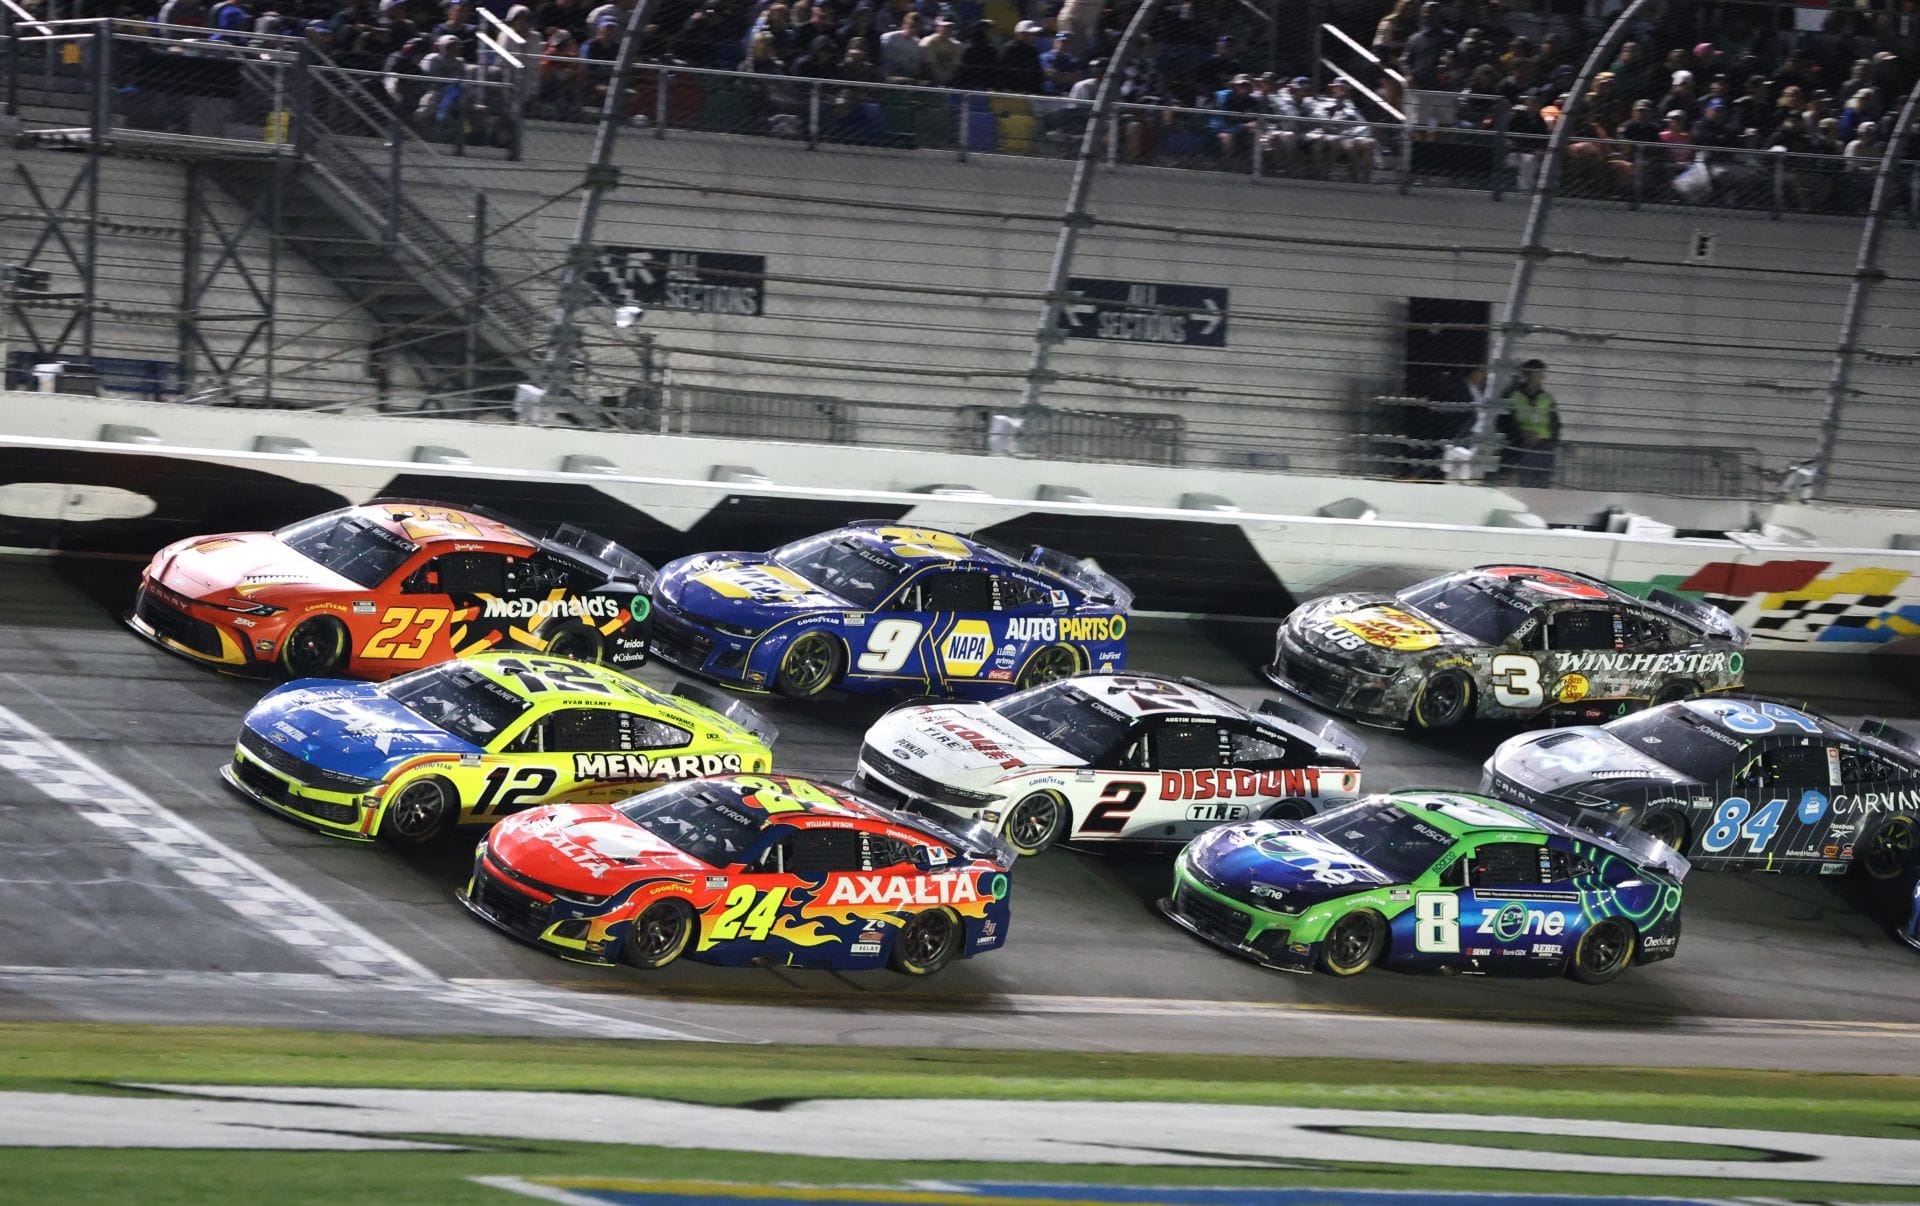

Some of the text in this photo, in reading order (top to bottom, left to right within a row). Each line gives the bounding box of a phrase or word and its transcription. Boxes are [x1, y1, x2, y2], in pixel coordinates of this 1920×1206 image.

[371, 527, 414, 552] WALLACE
[859, 550, 898, 570] ELLIOTT
[304, 602, 348, 612] GOODYEAR
[484, 595, 620, 618] McDonald's
[1494, 592, 1533, 614] DILLON
[359, 606, 451, 660] 23
[796, 616, 840, 626] GOODYEAR
[1004, 617, 1109, 642] AUTO PARTS
[623, 639, 645, 649] leidos
[857, 618, 923, 672] 9
[949, 635, 986, 661] NAPA
[1554, 652, 1726, 674] WINCHESTER
[1492, 654, 1544, 708] 3
[484, 683, 521, 704] BLANEY
[1090, 701, 1126, 722] CINDRIC
[1714, 699, 1824, 735] 84
[1695, 724, 1744, 750] JOHNSON
[573, 751, 742, 782] MENARDS
[470, 766, 558, 816] 12
[1029, 775, 1065, 787] GOODYEAR
[1159, 767, 1321, 801] DISCOUNT
[1493, 779, 1537, 805] CAMRY
[1078, 780, 1148, 834] 2
[1193, 806, 1242, 820] TIRE
[1647, 796, 1688, 808] GOODYEAR
[715, 803, 752, 826] BYRON
[805, 821, 831, 829] WILLIAM
[1701, 796, 1789, 853] 84
[1412, 822, 1452, 846] BUSCH
[649, 883, 694, 895] GOODYEAR
[826, 873, 978, 906] AXALTA
[1250, 884, 1285, 900] zone
[708, 884, 788, 942] 24
[1415, 891, 1461, 954] 8
[1476, 901, 1566, 942] zone
[859, 944, 881, 953] RELAY
[1532, 943, 1564, 955] REBEL
